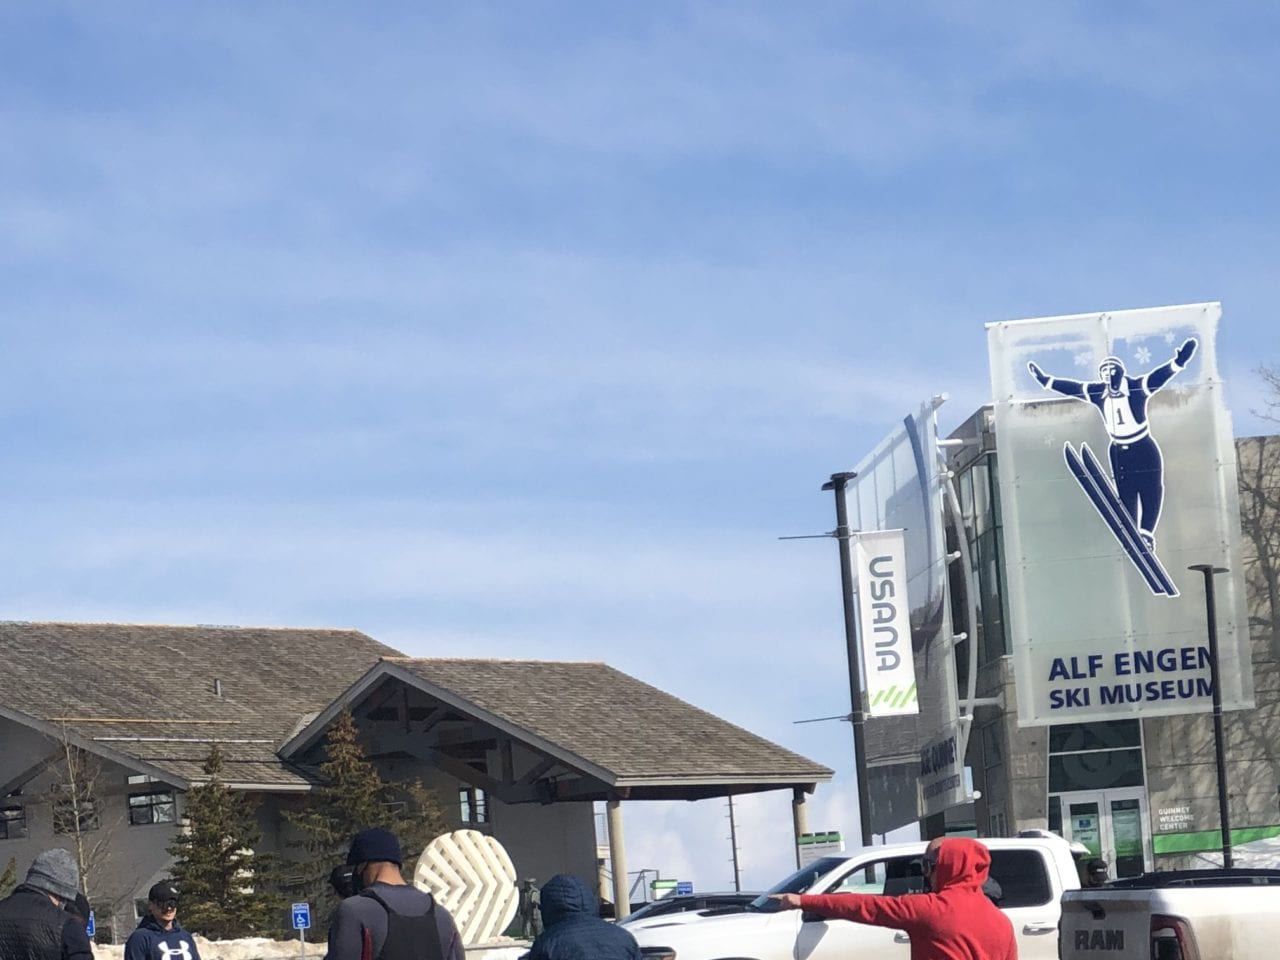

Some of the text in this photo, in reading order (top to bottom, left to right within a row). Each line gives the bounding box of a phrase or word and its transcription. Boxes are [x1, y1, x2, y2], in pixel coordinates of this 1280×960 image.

[1116, 408, 1126, 426] 1
[869, 555, 901, 671] USANA
[1048, 646, 1212, 682] ALF ENGEN
[1049, 677, 1214, 710] SKI MUSEUM
[1160, 814, 1194, 823] WELCOME
[1160, 822, 1188, 830] CENTER
[1074, 929, 1125, 950] RAM
